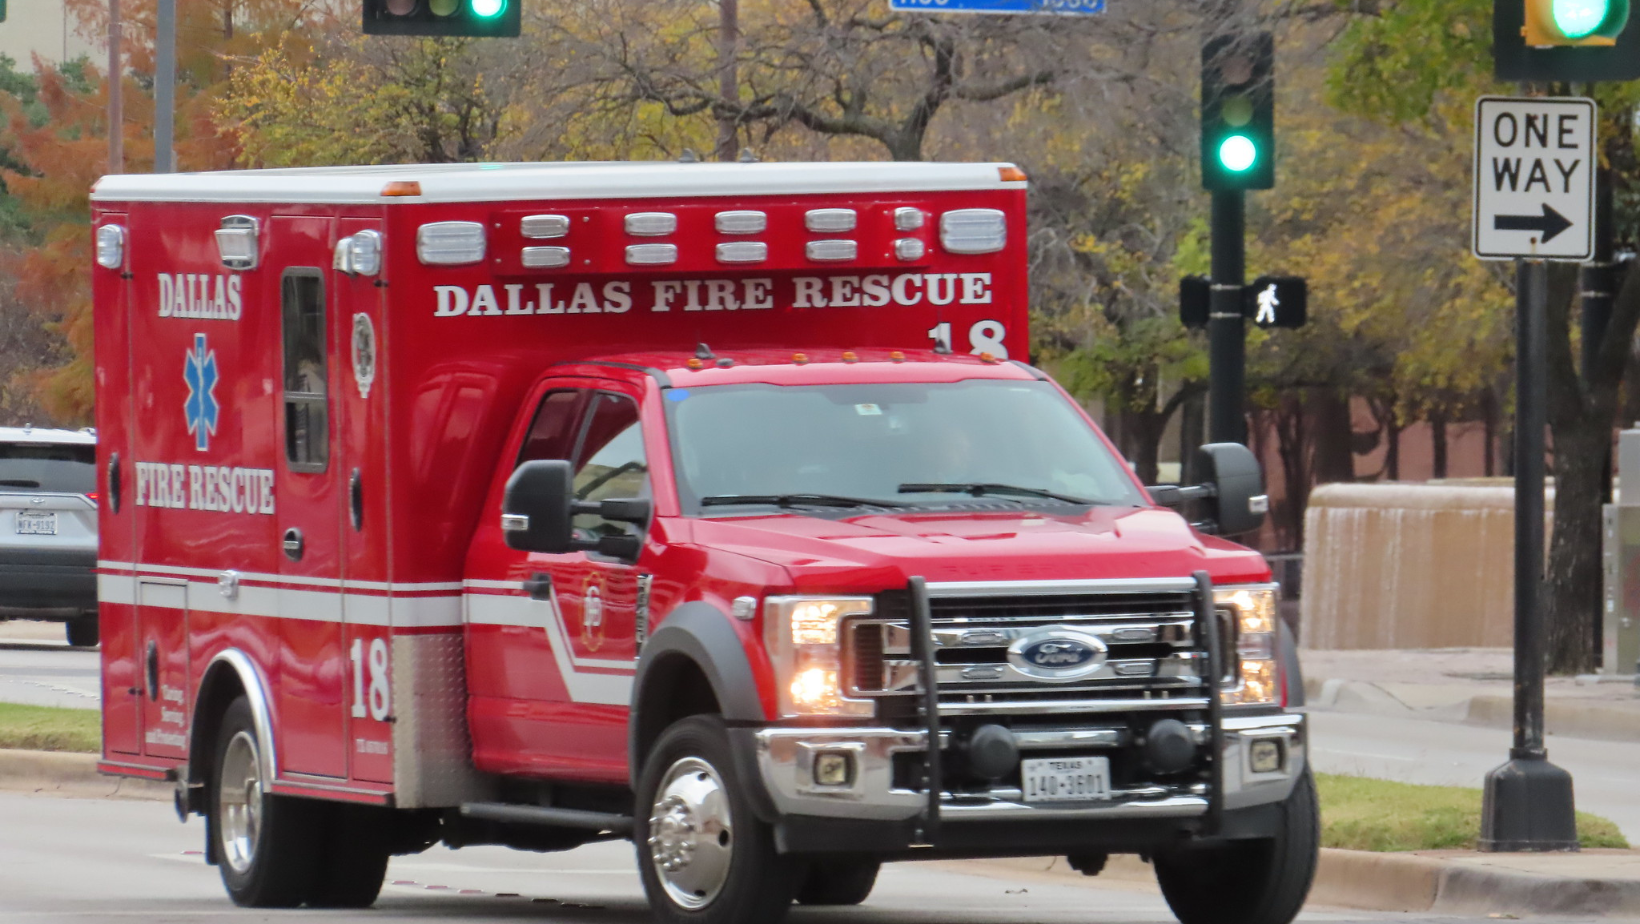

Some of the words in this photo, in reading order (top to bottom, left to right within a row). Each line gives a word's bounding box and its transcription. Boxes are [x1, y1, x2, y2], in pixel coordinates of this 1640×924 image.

[1494, 112, 1579, 149] ONE
[1493, 157, 1581, 193] WAY
[158, 273, 242, 321] DALLAS
[434, 281, 631, 317] DALLAS
[651, 278, 773, 312] FIRE
[792, 272, 992, 308] RESCUE
[928, 319, 1009, 360] 18
[135, 461, 185, 509] FIRE
[189, 465, 275, 514] RESCUE
[350, 638, 389, 721] 18
